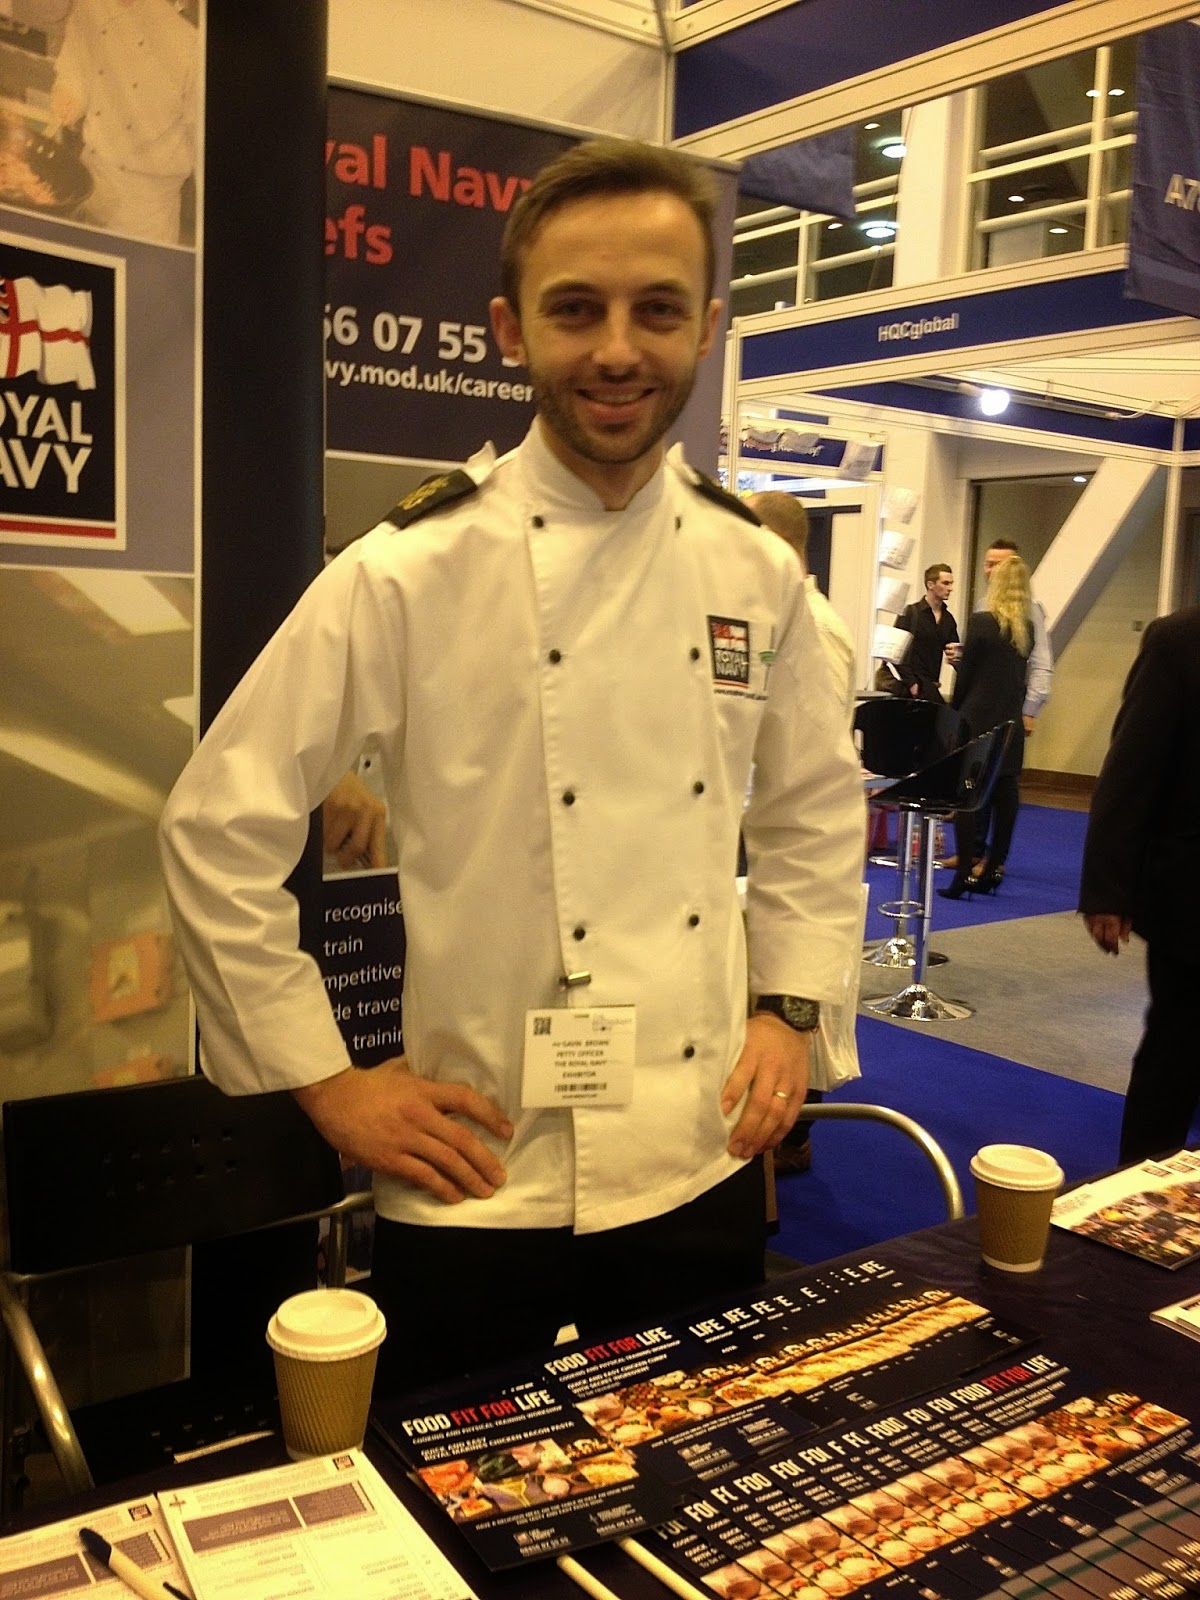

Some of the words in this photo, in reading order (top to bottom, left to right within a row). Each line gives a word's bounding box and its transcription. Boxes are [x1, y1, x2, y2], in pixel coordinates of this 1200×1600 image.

[1164, 174, 1200, 212] A7
[373, 311, 423, 355] 07
[438, 320, 487, 363] 55
[878, 312, 959, 342] HQCglobal
[0, 391, 93, 445] YAL
[323, 936, 363, 957] train
[357, 997, 400, 1018] trave
[688, 1318, 725, 1338] LIFE
[544, 1352, 588, 1376] FOOD
[583, 1344, 611, 1362] FIT
[607, 1336, 642, 1355] FOR
[635, 1326, 673, 1347] LIFE
[949, 1382, 993, 1405] FOOD
[980, 1374, 1010, 1392] FIT
[999, 1365, 1035, 1384] FOR
[1020, 1354, 1059, 1375] LIFE
[401, 1413, 451, 1437] FOOD
[450, 1407, 480, 1426] FIT
[479, 1399, 518, 1420] FOR
[514, 1389, 556, 1411] LIFE
